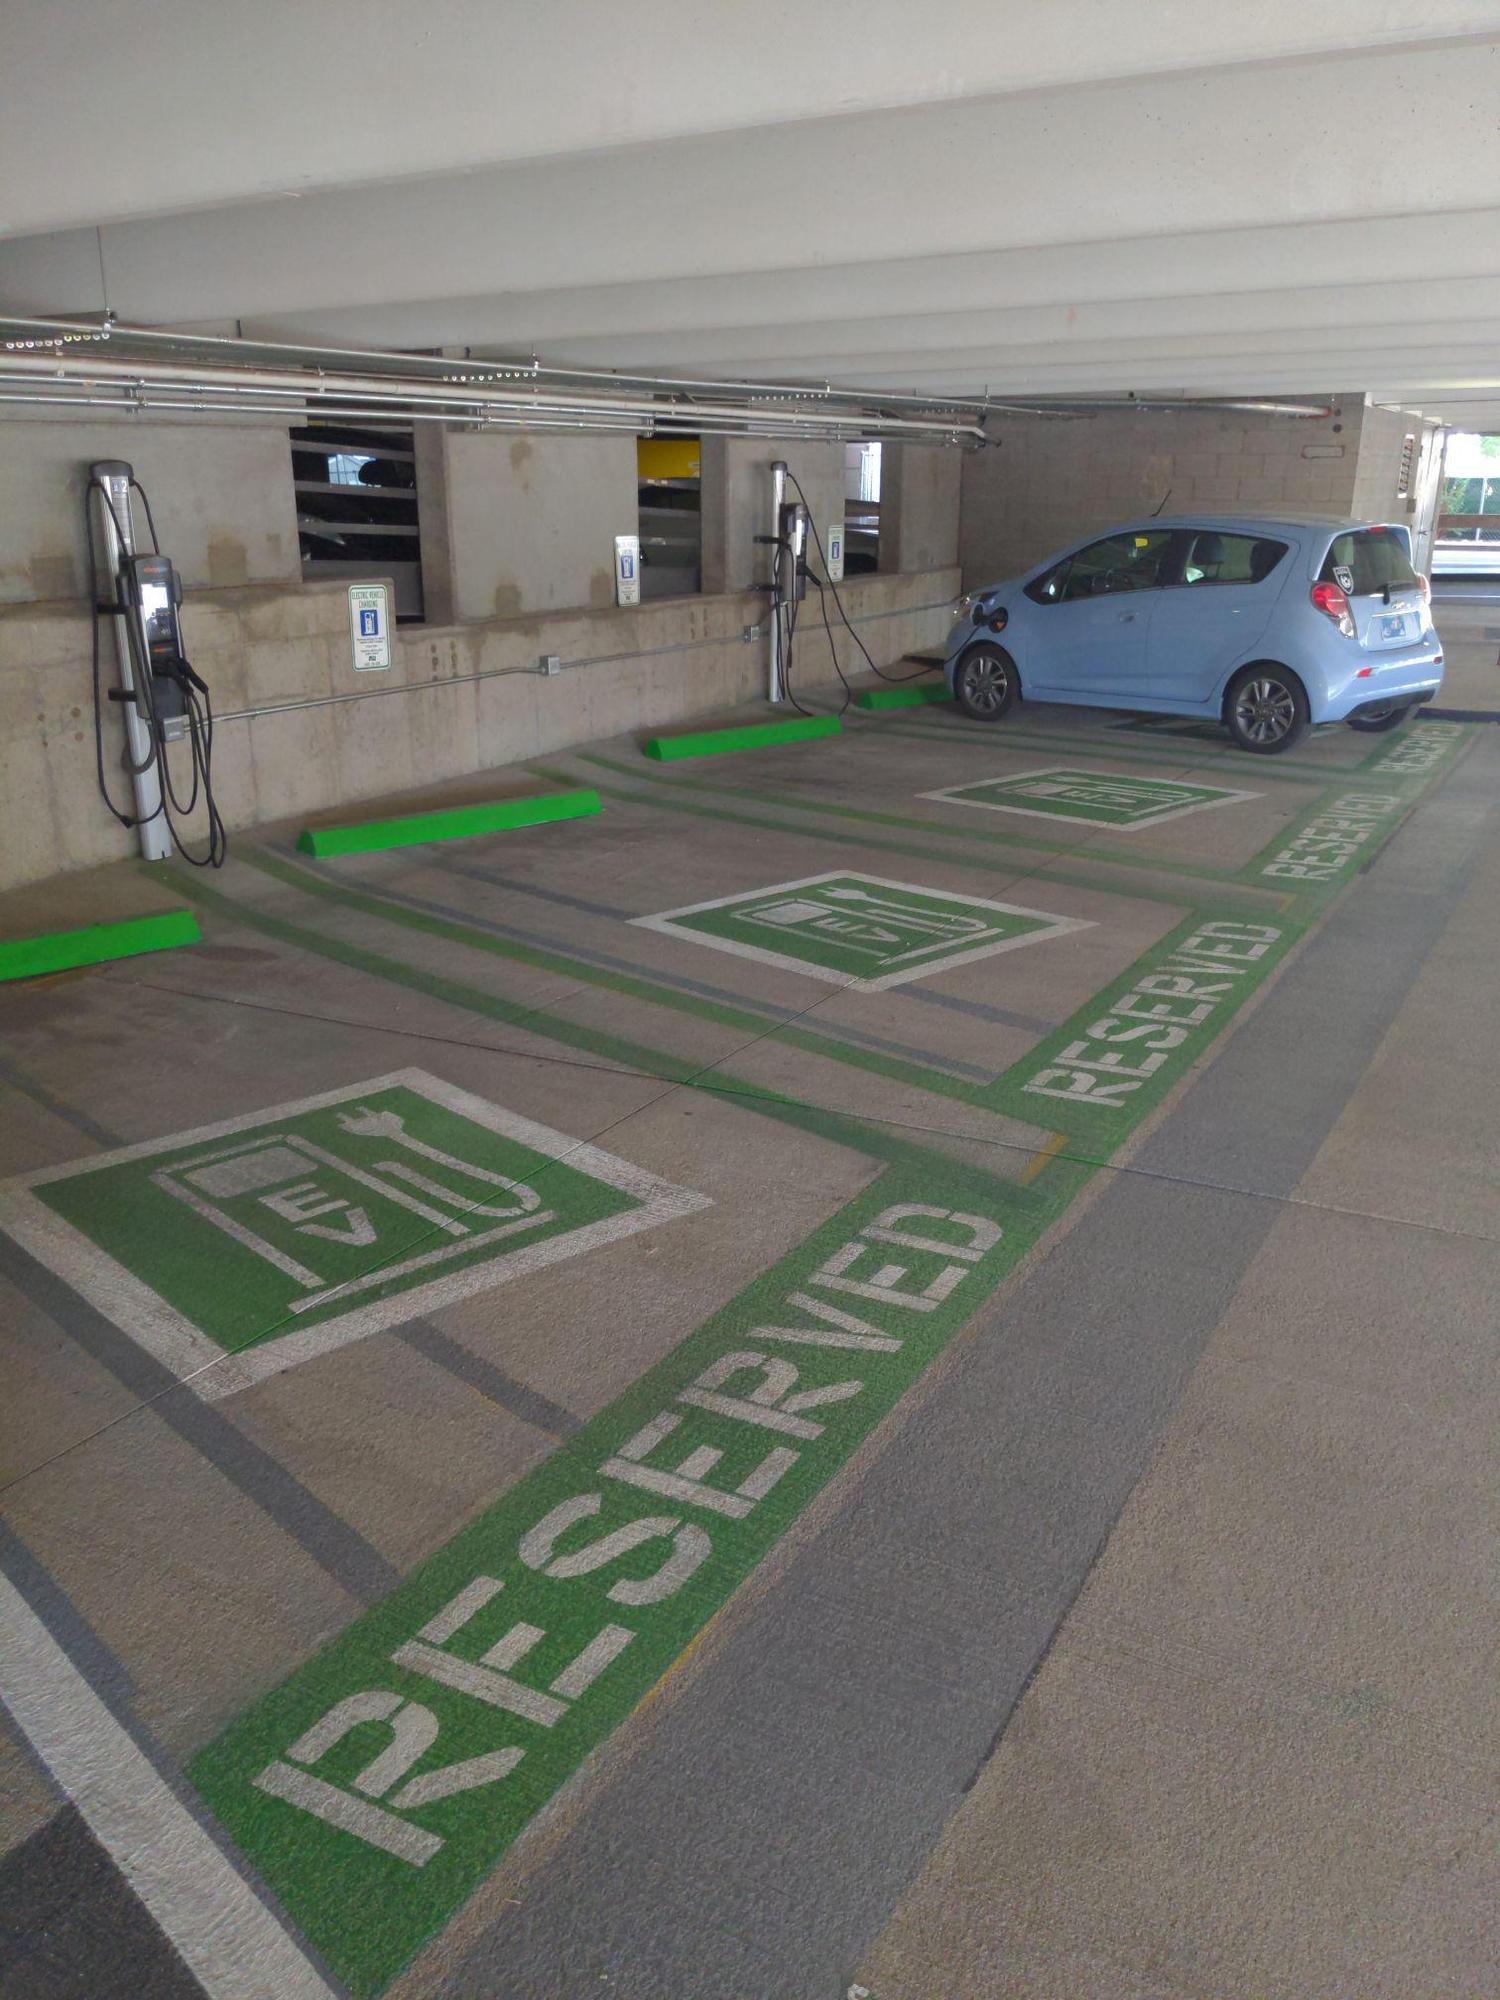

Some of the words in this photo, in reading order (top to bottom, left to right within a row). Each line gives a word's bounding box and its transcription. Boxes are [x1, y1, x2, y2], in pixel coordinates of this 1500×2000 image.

[1368, 723, 1465, 773] RESERVED
[1261, 793, 1400, 881] RESERVED
[810, 917, 900, 942] EV
[1021, 921, 1282, 1107] RESERVED
[257, 1182, 378, 1247] EV
[252, 1203, 1003, 1868] RESERVED
